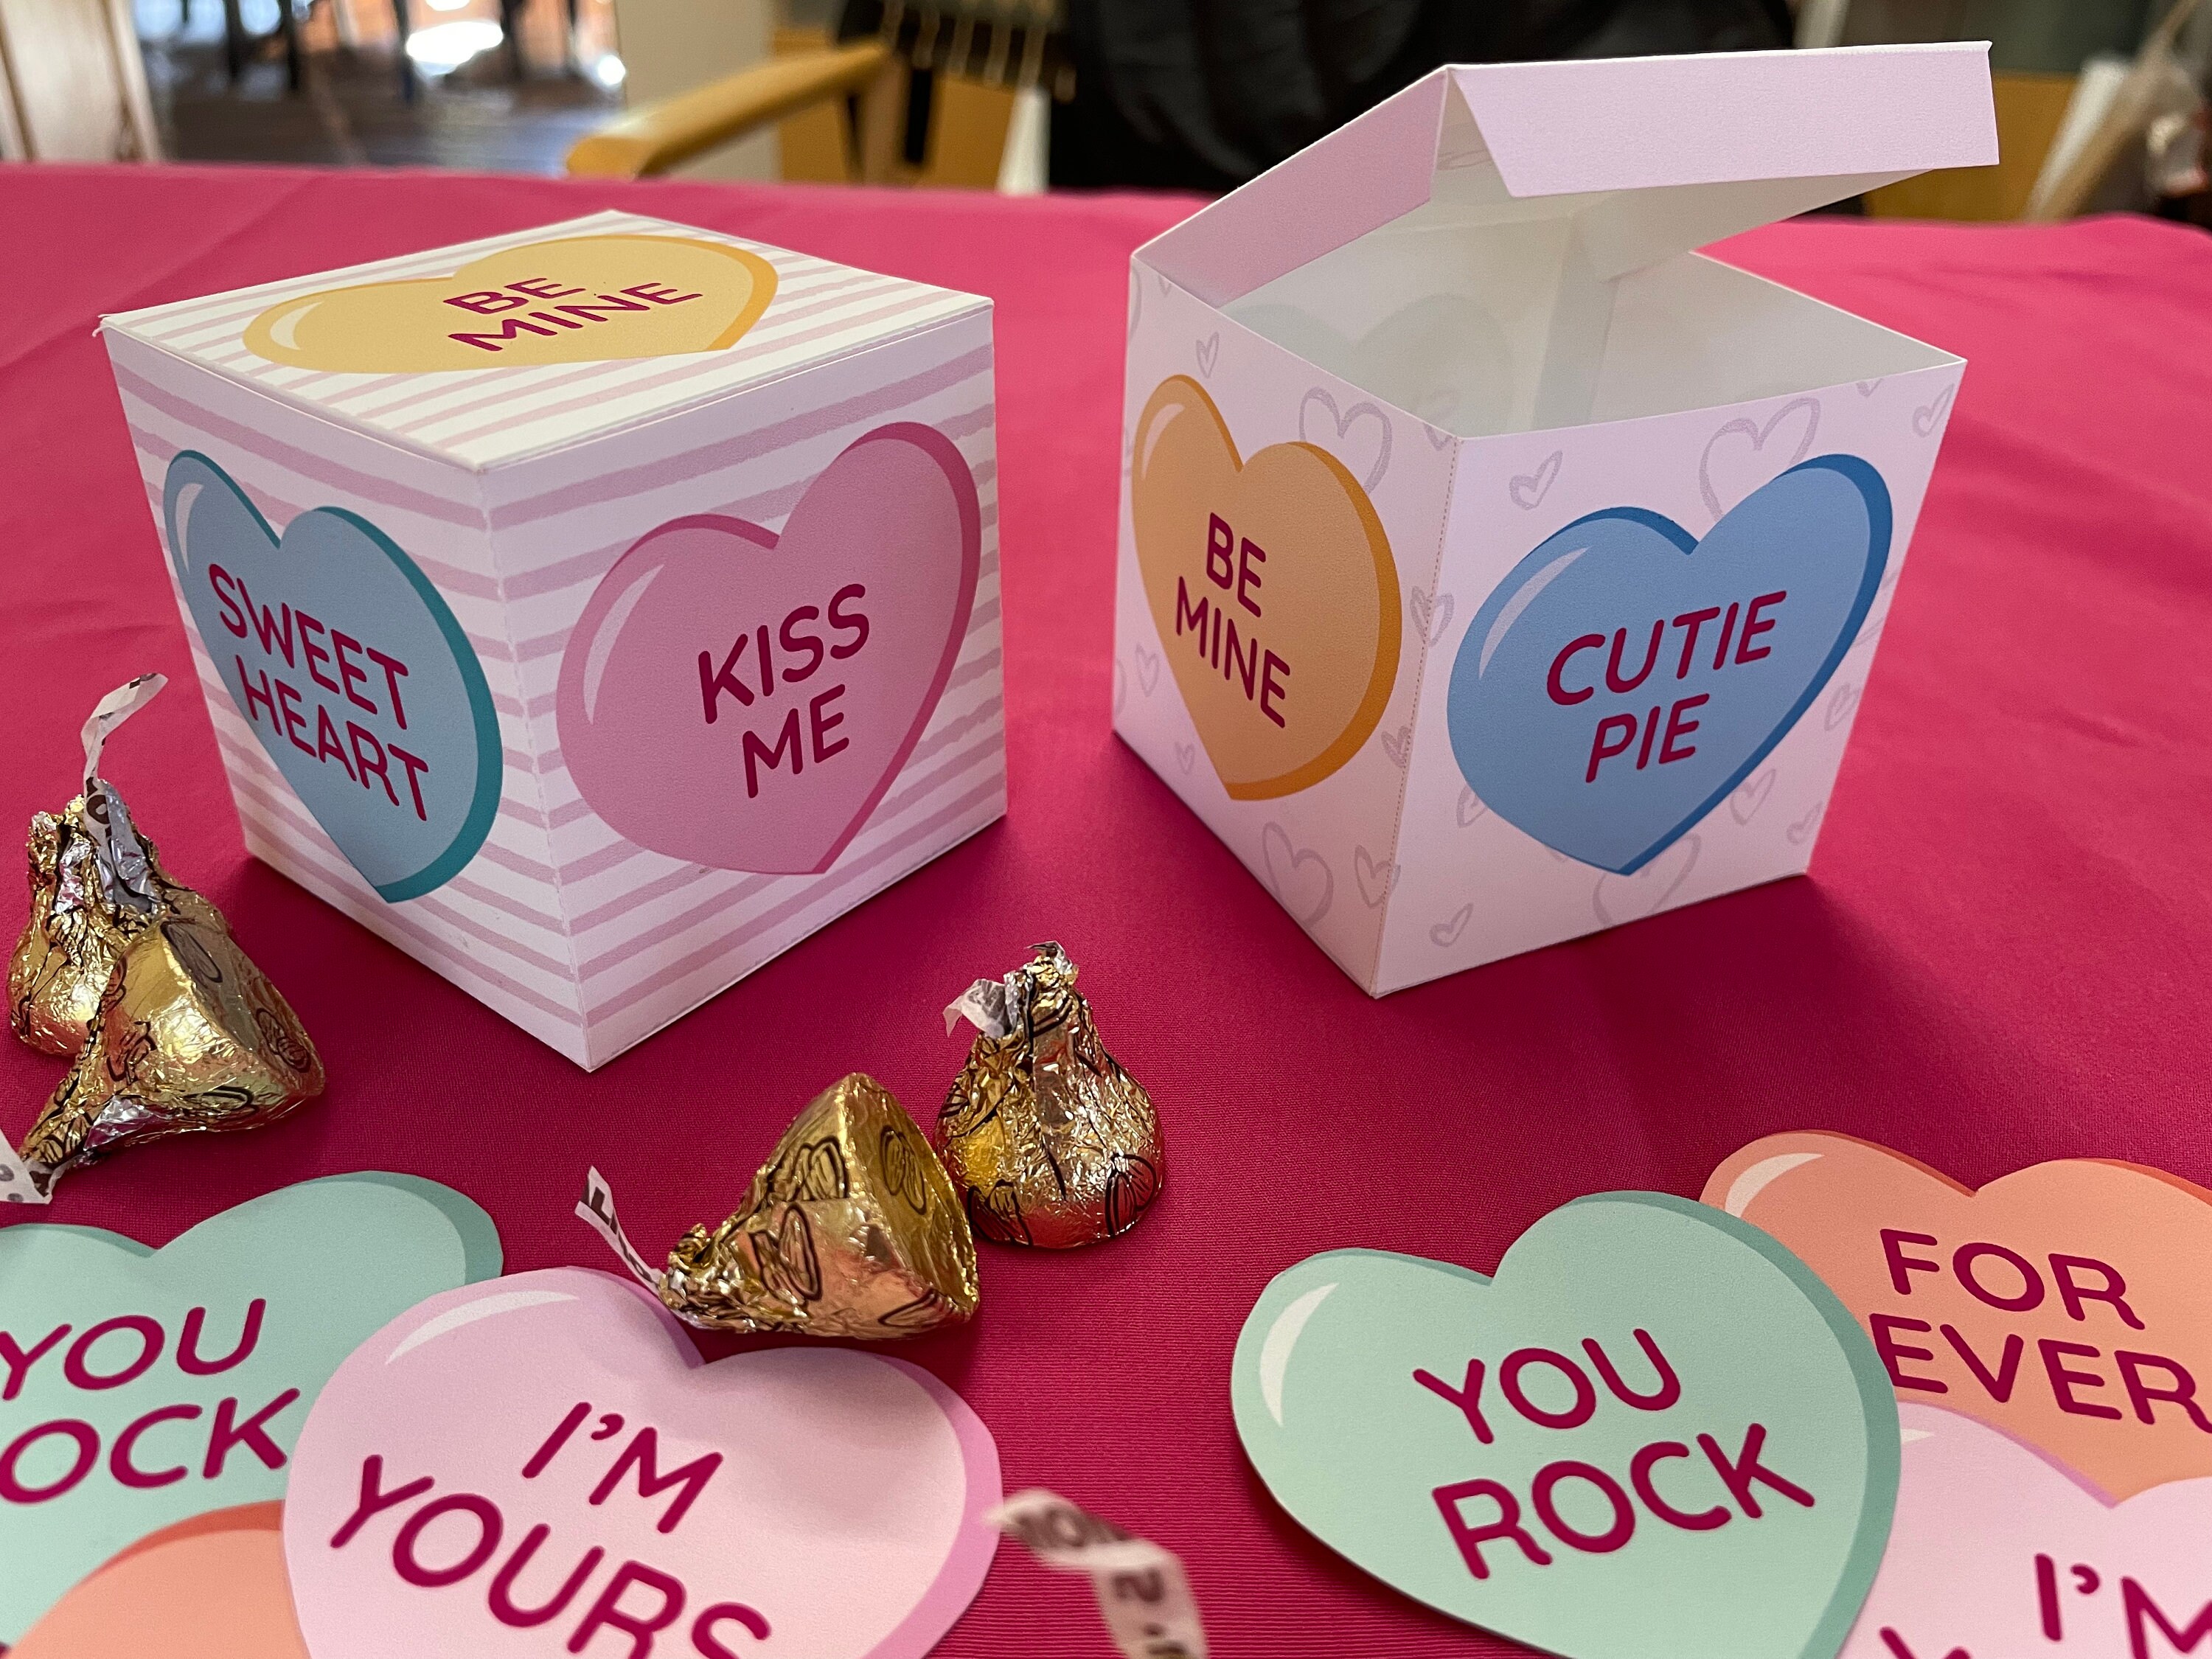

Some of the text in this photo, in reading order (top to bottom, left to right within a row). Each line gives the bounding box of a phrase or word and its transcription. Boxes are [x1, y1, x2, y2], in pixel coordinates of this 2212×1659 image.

[442, 276, 587, 314] BE
[448, 282, 703, 352] MINE
[1206, 514, 1266, 616] BE
[208, 563, 408, 730] SWEET
[697, 582, 871, 726] KISS
[1177, 575, 1290, 727] MINE
[1546, 591, 1787, 706] CUTIE
[235, 657, 428, 821] HEART
[741, 683, 851, 800] ME
[1585, 693, 1710, 783] PIE
[1878, 1228, 2146, 1331] FOR
[0, 1298, 266, 1402] YOU
[1412, 1328, 1681, 1445] YOU
[1868, 1312, 2212, 1435] EVER
[521, 1401, 724, 1534] I'M
[1431, 1422, 1815, 1580] ROCK
